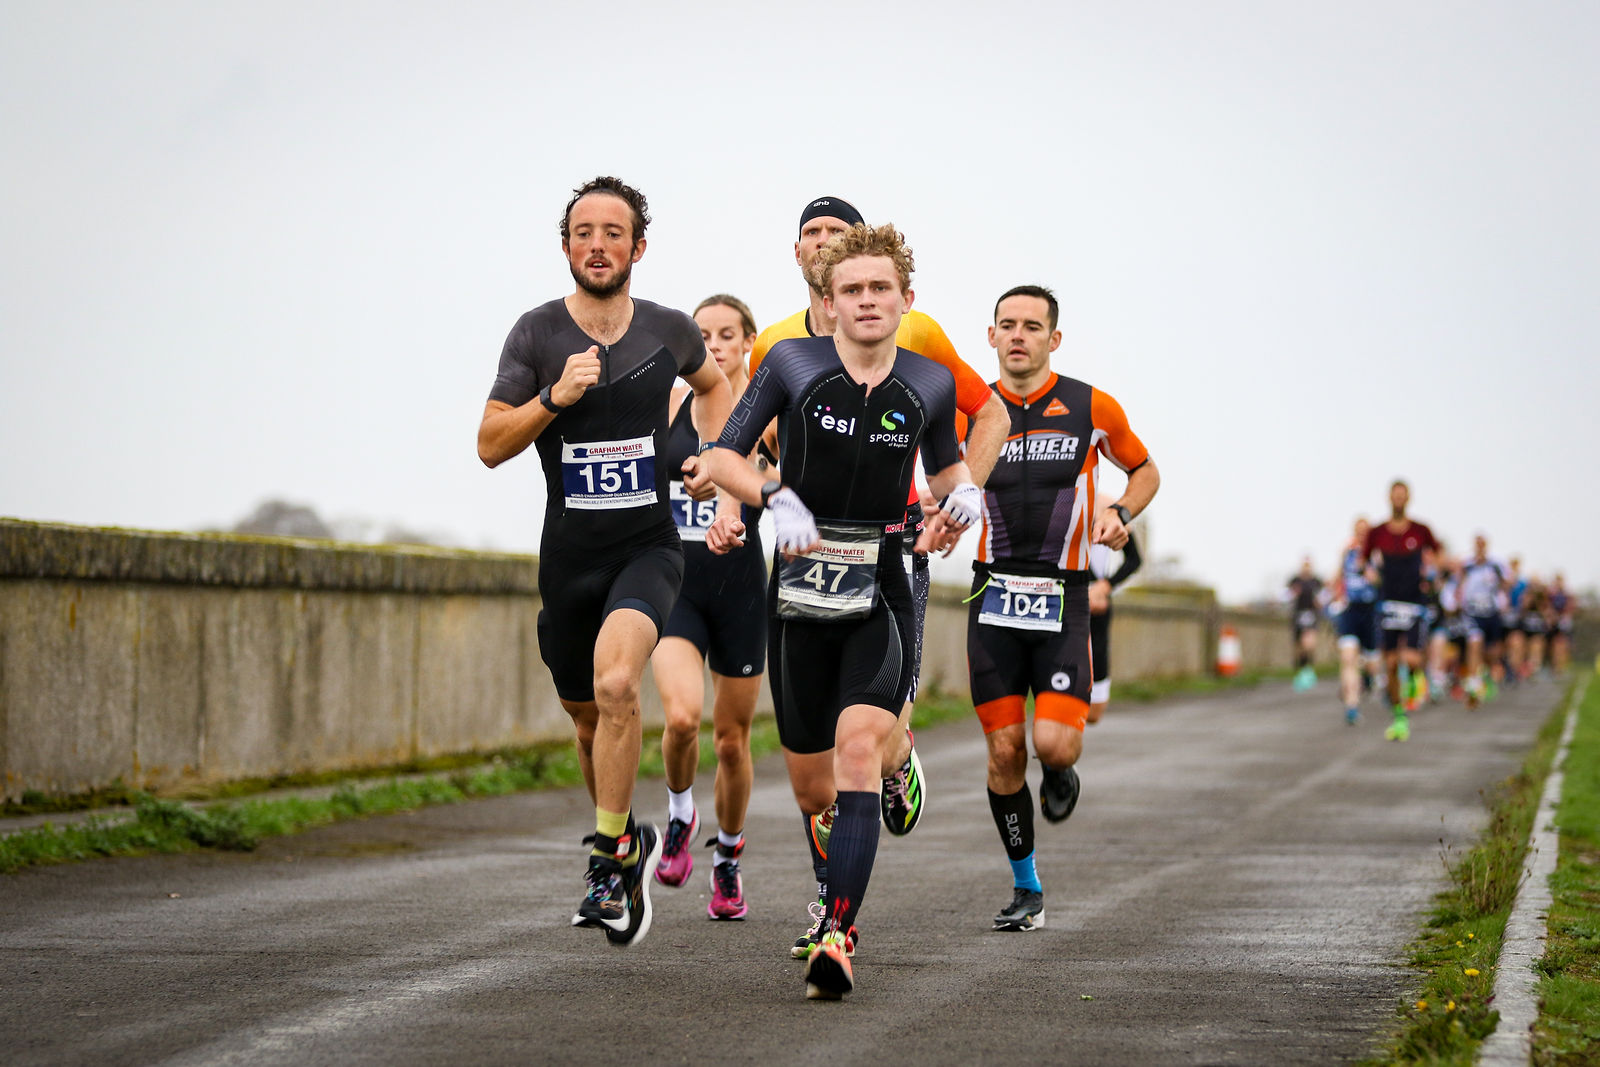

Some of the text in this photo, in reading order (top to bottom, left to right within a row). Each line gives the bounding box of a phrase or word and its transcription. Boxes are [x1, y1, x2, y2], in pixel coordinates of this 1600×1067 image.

[821, 414, 856, 435] esl
[869, 433, 910, 443] SPOKES
[589, 443, 643, 455] GRAFHAM WATER
[579, 460, 639, 493] 151
[843, 548, 865, 556] WATER
[804, 562, 849, 593] 47
[1000, 591, 1050, 618] 104
